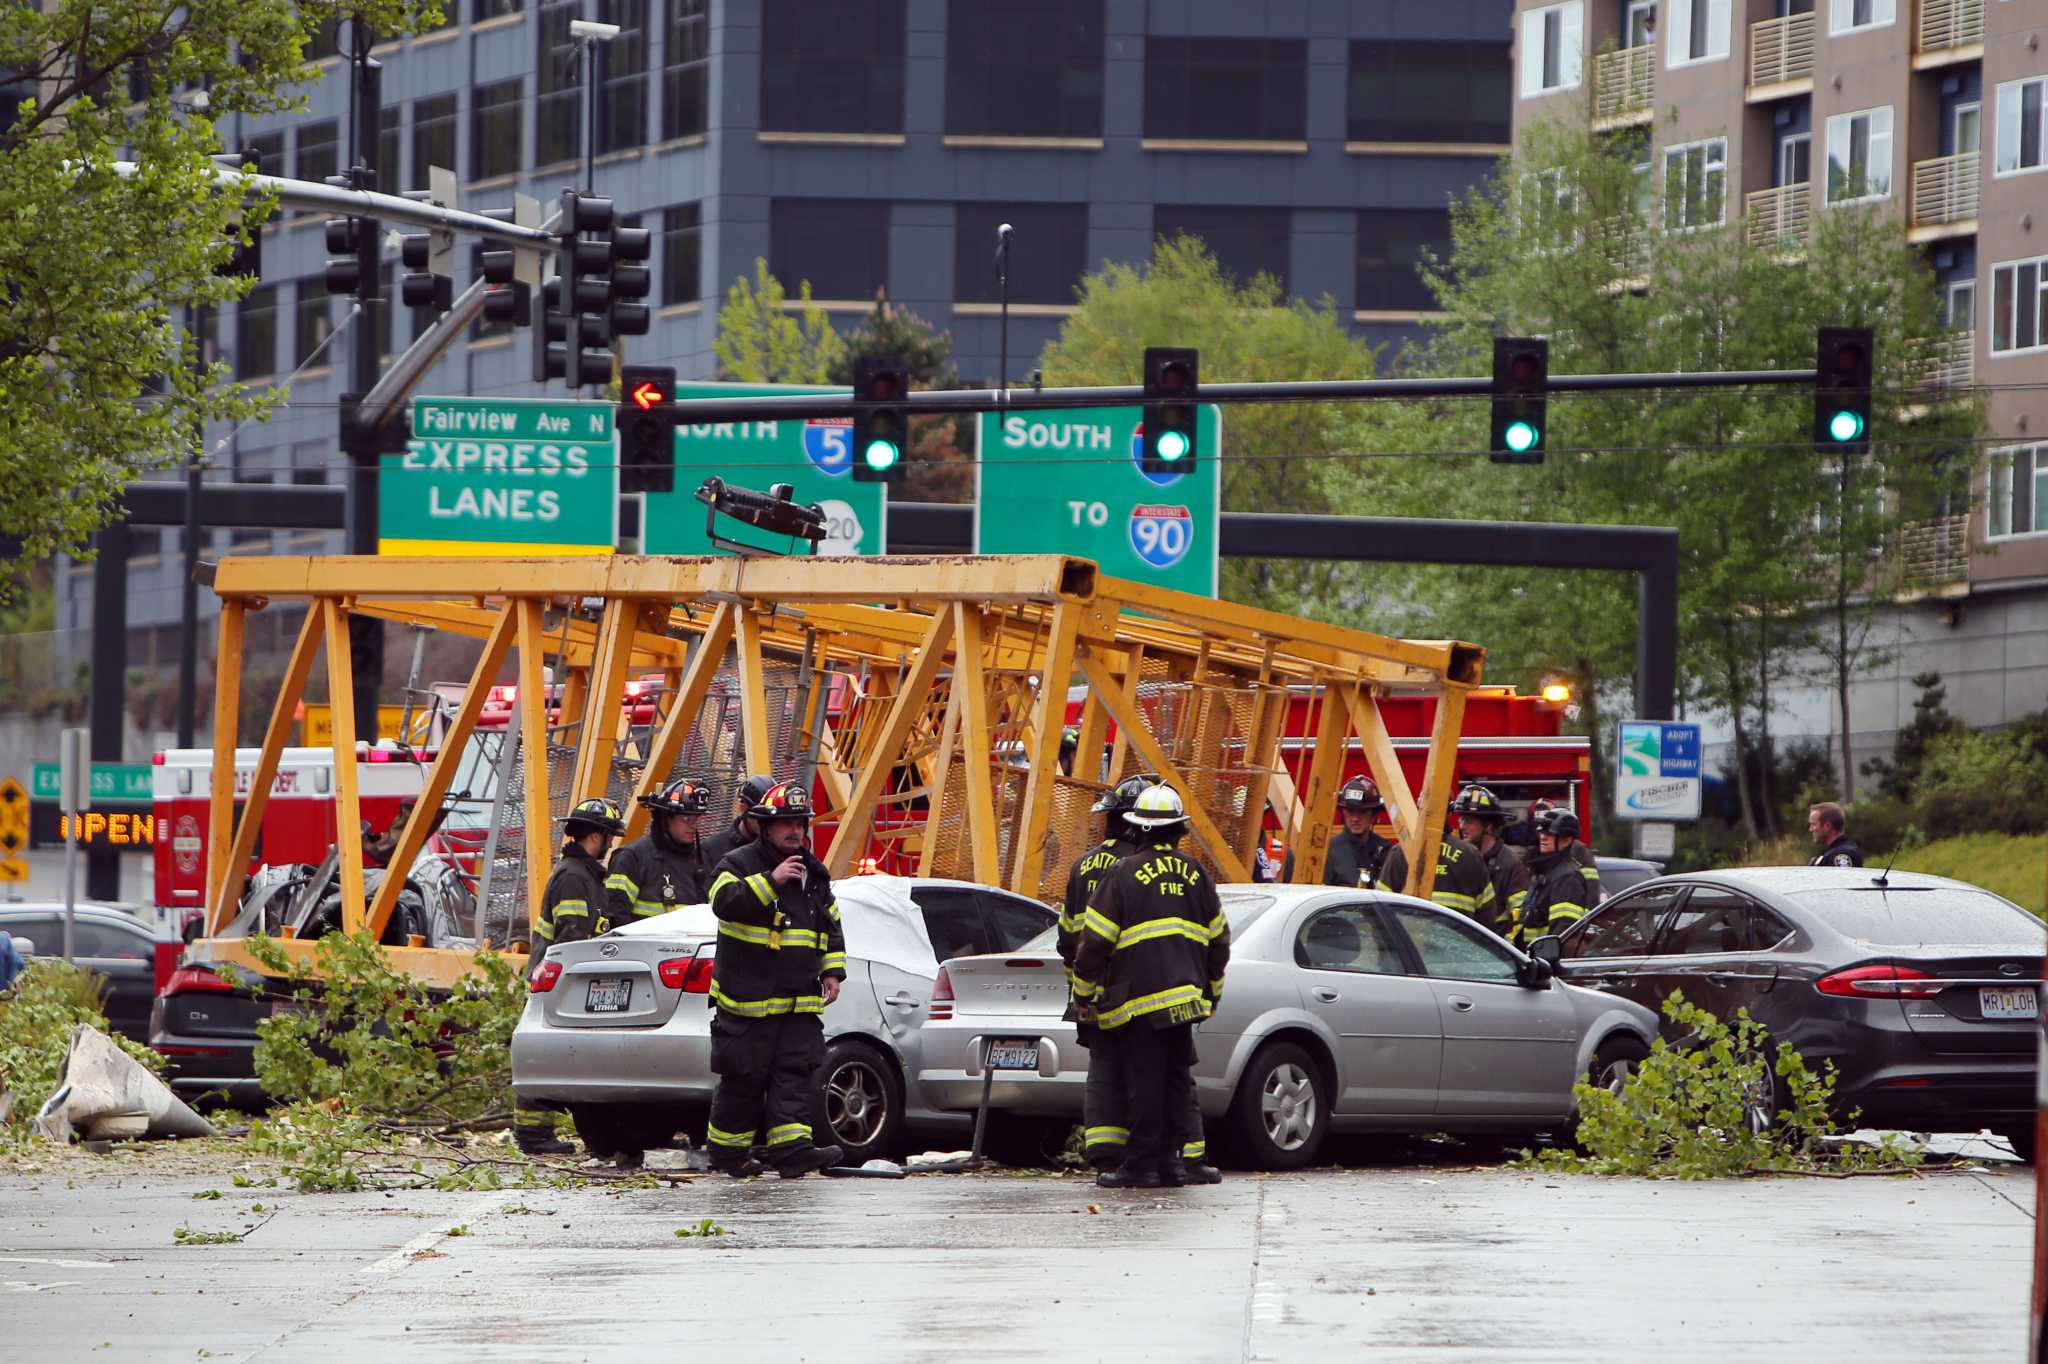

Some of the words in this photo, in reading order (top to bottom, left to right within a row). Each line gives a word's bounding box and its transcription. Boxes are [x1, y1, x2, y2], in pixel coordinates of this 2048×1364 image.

[423, 407, 517, 430] Fairview
[537, 412, 571, 432] Ave
[589, 415, 604, 433] N
[1003, 417, 1111, 449] SOUTH
[403, 441, 588, 476] EXPRESS
[822, 428, 847, 465] 5
[430, 486, 560, 520] LANES
[1068, 501, 1108, 526] TO
[828, 517, 854, 540] 20
[1137, 519, 1184, 554] 90
[1134, 856, 1200, 886] SEATTLE
[1160, 881, 1184, 895] FIRE
[593, 1004, 618, 1012] LITHIA
